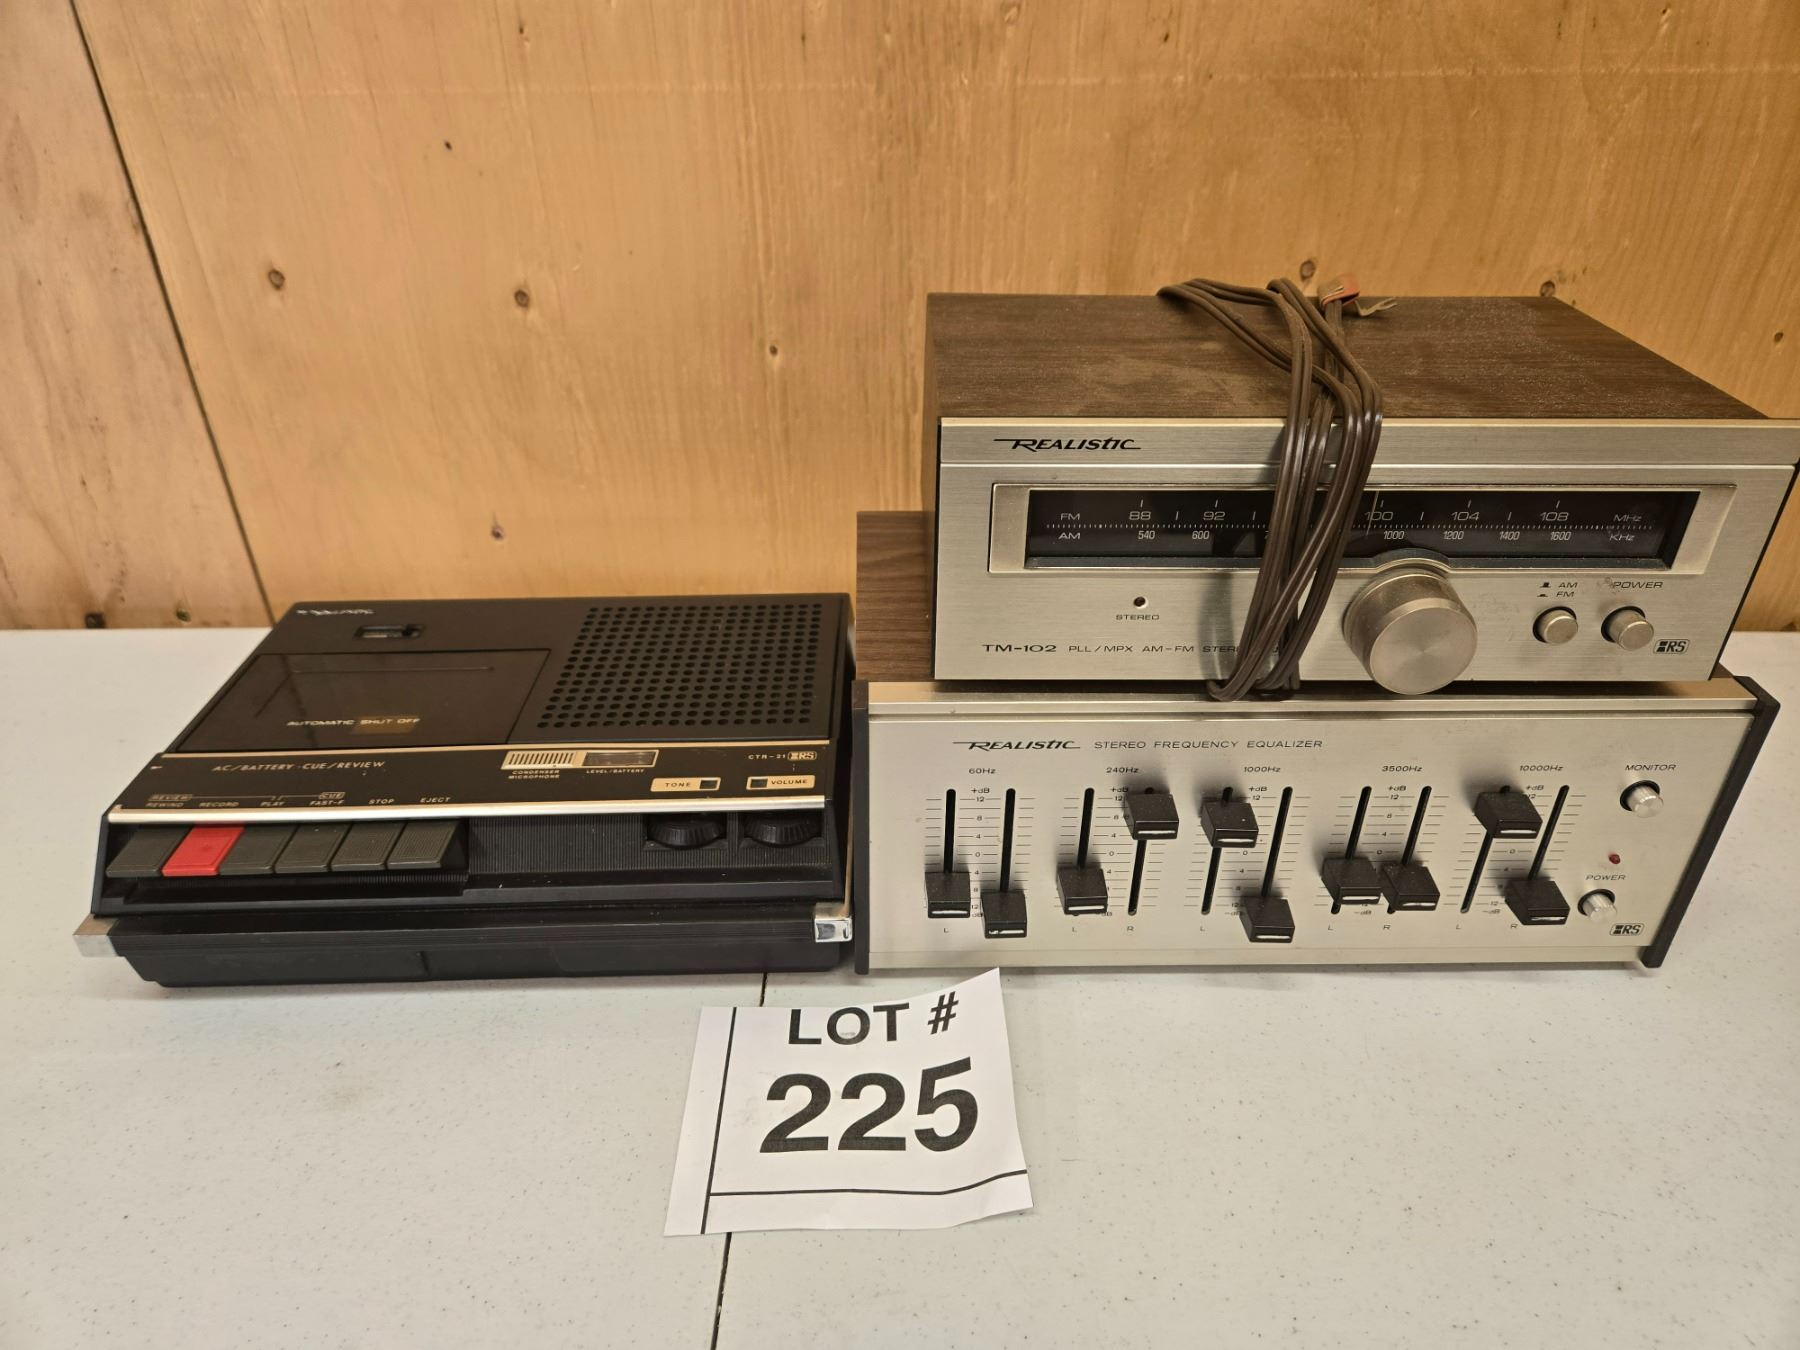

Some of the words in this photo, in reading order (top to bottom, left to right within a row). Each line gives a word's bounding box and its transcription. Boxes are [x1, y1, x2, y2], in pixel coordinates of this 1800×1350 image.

[1060, 512, 1081, 520] FM
[1129, 510, 1151, 521] 88
[1203, 510, 1226, 521] 92
[1364, 511, 1394, 521] 100
[1451, 511, 1480, 521] 104
[1539, 511, 1570, 521] 108
[1613, 513, 1642, 521] MHz
[1058, 531, 1081, 540] AM
[1138, 530, 1156, 540] 540
[1191, 530, 1210, 540] 600
[1383, 530, 1405, 540] 1000
[1443, 530, 1465, 540] 1200
[1499, 531, 1520, 541] 1400
[1550, 531, 1572, 541] 1600
[1609, 533, 1635, 542] KHz
[1612, 581, 1664, 589] POWER
[1556, 590, 1575, 598] FM
[1115, 613, 1160, 621] STEREO
[982, 644, 1058, 653] TM-102
[287, 719, 355, 727] AUTOMATIC
[360, 718, 394, 726] SHUT
[397, 717, 421, 725] OFF
[1094, 741, 1147, 749] STEREO
[1154, 740, 1239, 749] FREQUENCY
[1247, 740, 1323, 749] EQUALIZER
[969, 767, 997, 775] 60Hz
[1519, 764, 1564, 772] 10000Hz
[788, 1001, 910, 1046] LOT
[927, 991, 960, 1035] #
[759, 1056, 979, 1153] 225
